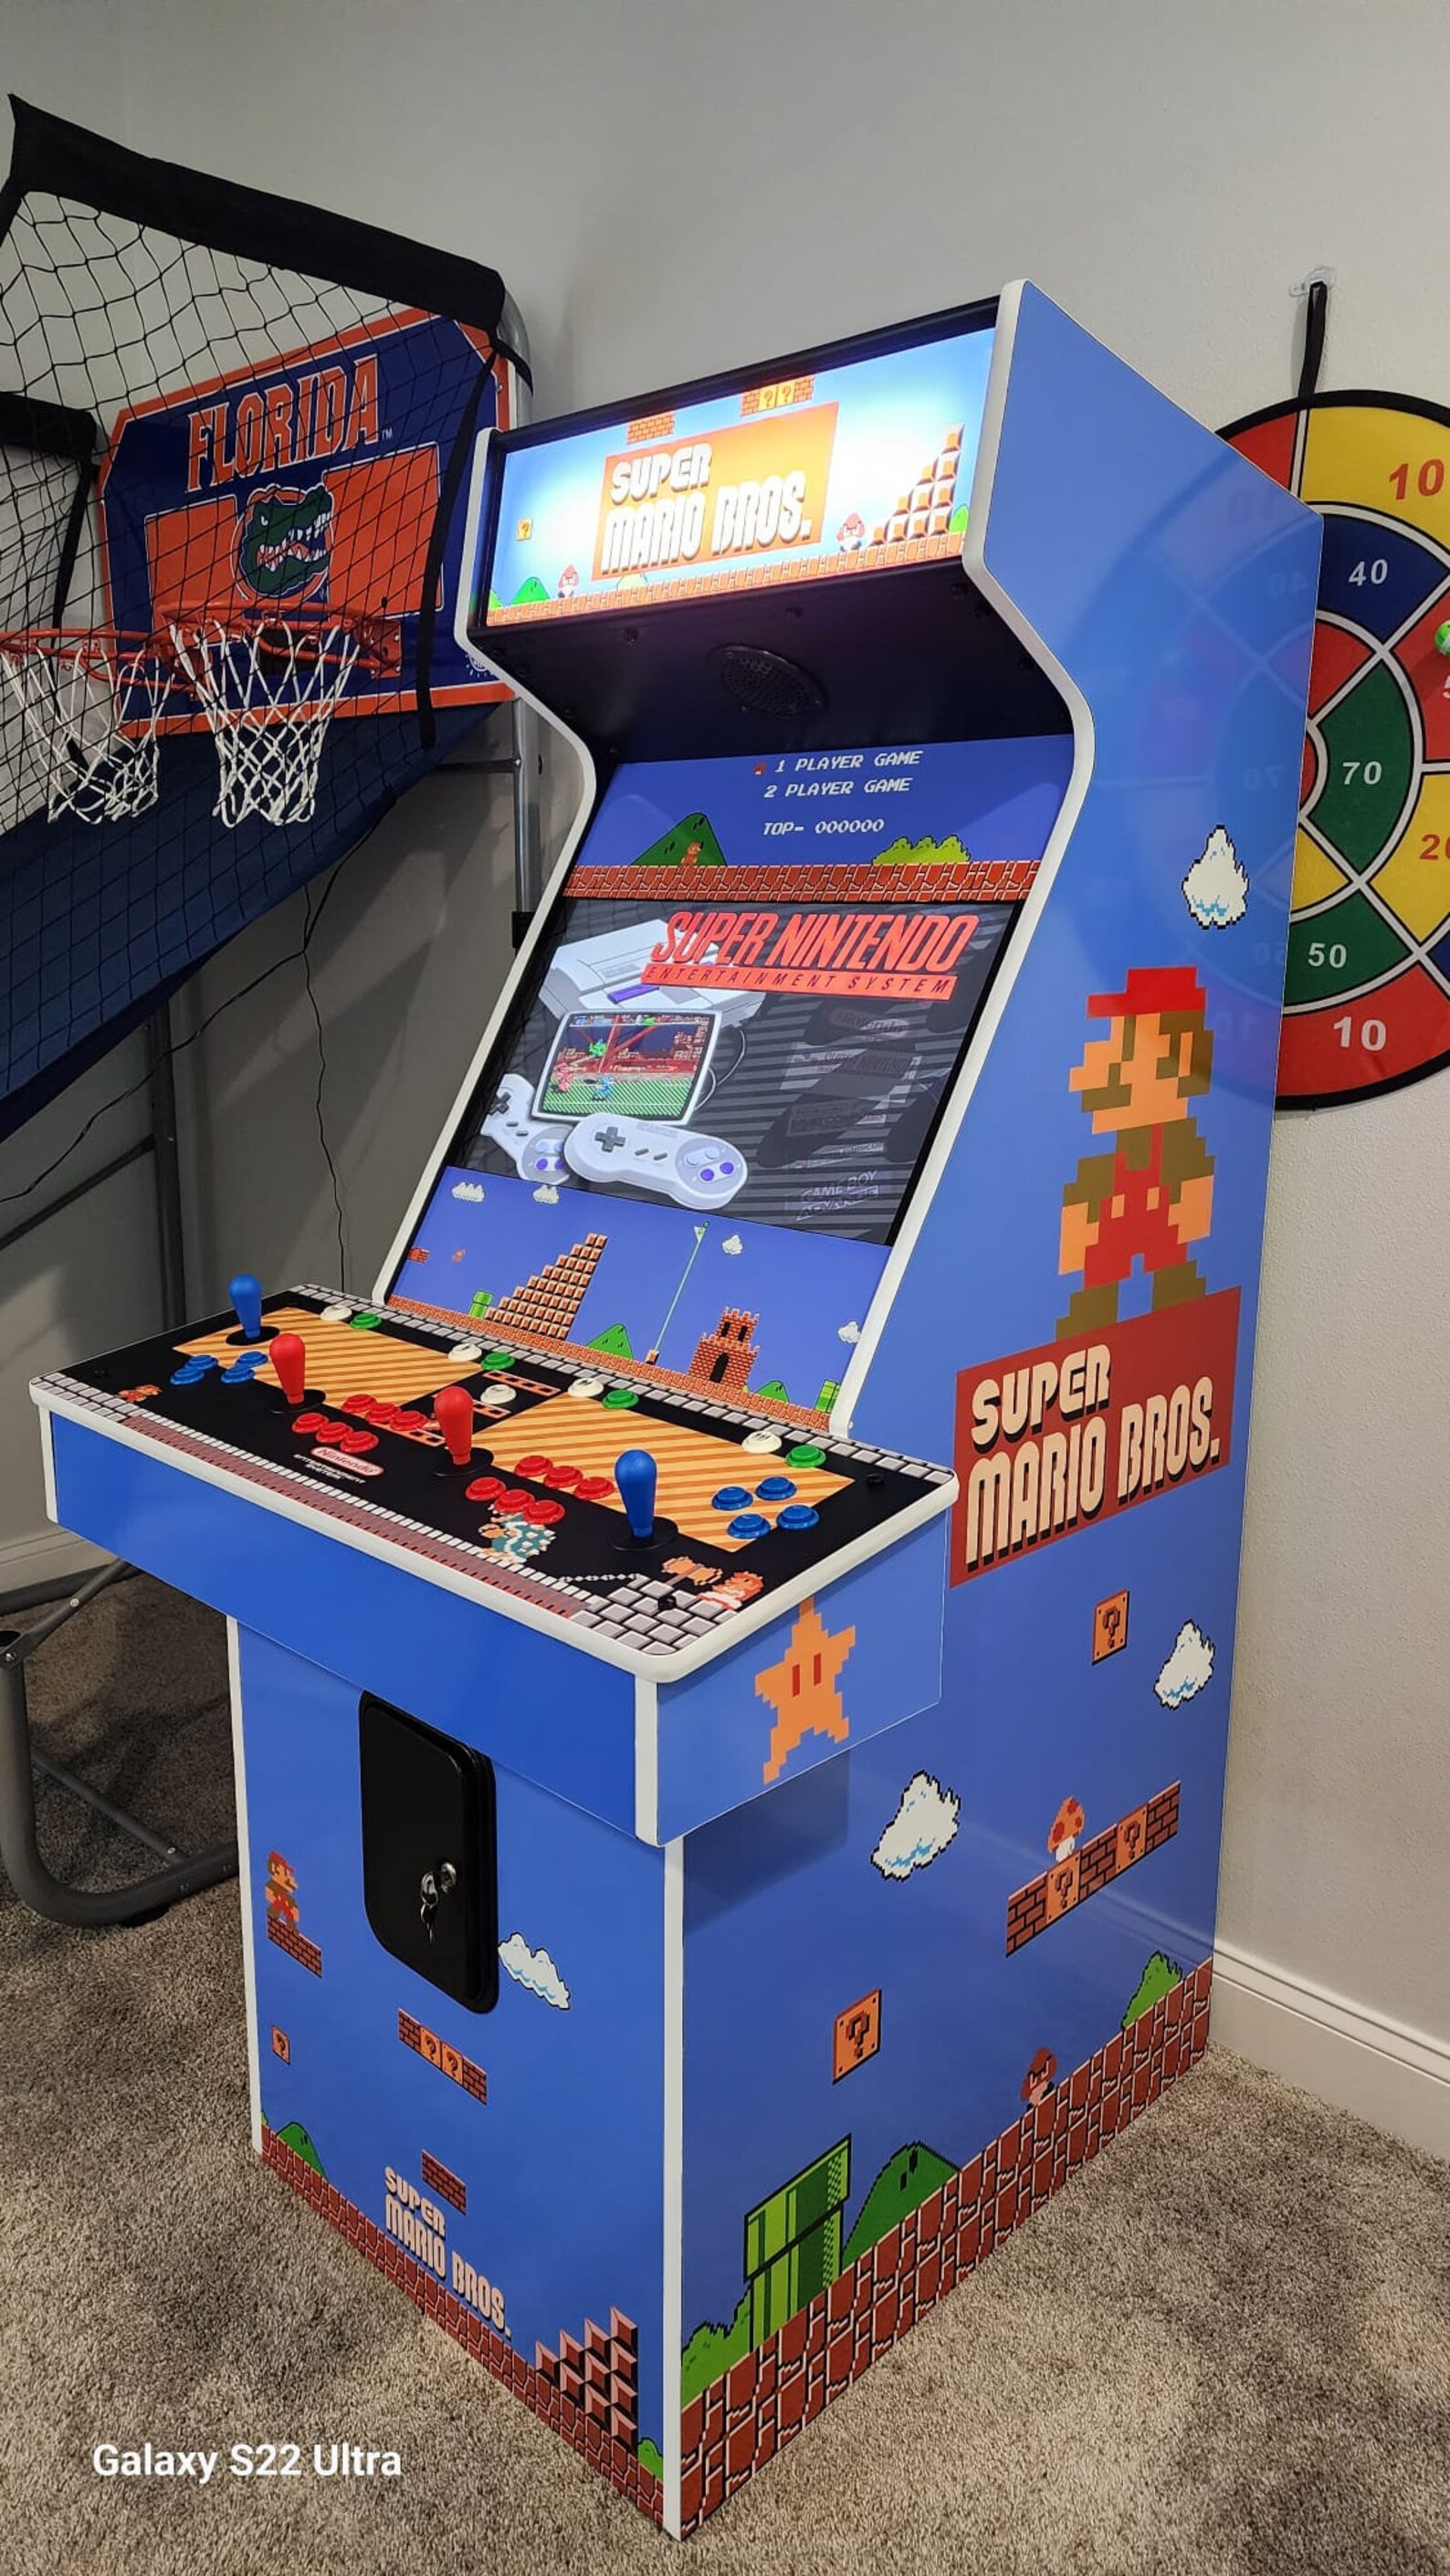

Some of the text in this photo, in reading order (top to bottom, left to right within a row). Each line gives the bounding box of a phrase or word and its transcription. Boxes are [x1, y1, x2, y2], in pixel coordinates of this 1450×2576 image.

[184, 353, 379, 493] FLORIDA
[610, 442, 712, 506] SUPER
[1389, 458, 1445, 500] 10
[600, 470, 813, 575] MARIO BROS.
[1349, 558, 1388, 587] 40
[775, 750, 924, 773] 1 PLAYER GAME
[1341, 761, 1382, 785] 70
[763, 777, 913, 798] 2 PLAYER GAME
[814, 818, 885, 834] 000000
[650, 911, 980, 973] SUPER NINTENDO
[1308, 942, 1347, 968] 50
[646, 965, 951, 994] ENTERTAINMENT SYSTEM
[1333, 1016, 1387, 1051] 10
[971, 1343, 1112, 1452] SUPER
[317, 1448, 375, 1474] Nintendo
[965, 1376, 1221, 1573] MARIO BROS.
[384, 2166, 446, 2237] SUPER
[385, 2193, 512, 2340] MARIO BROS.
